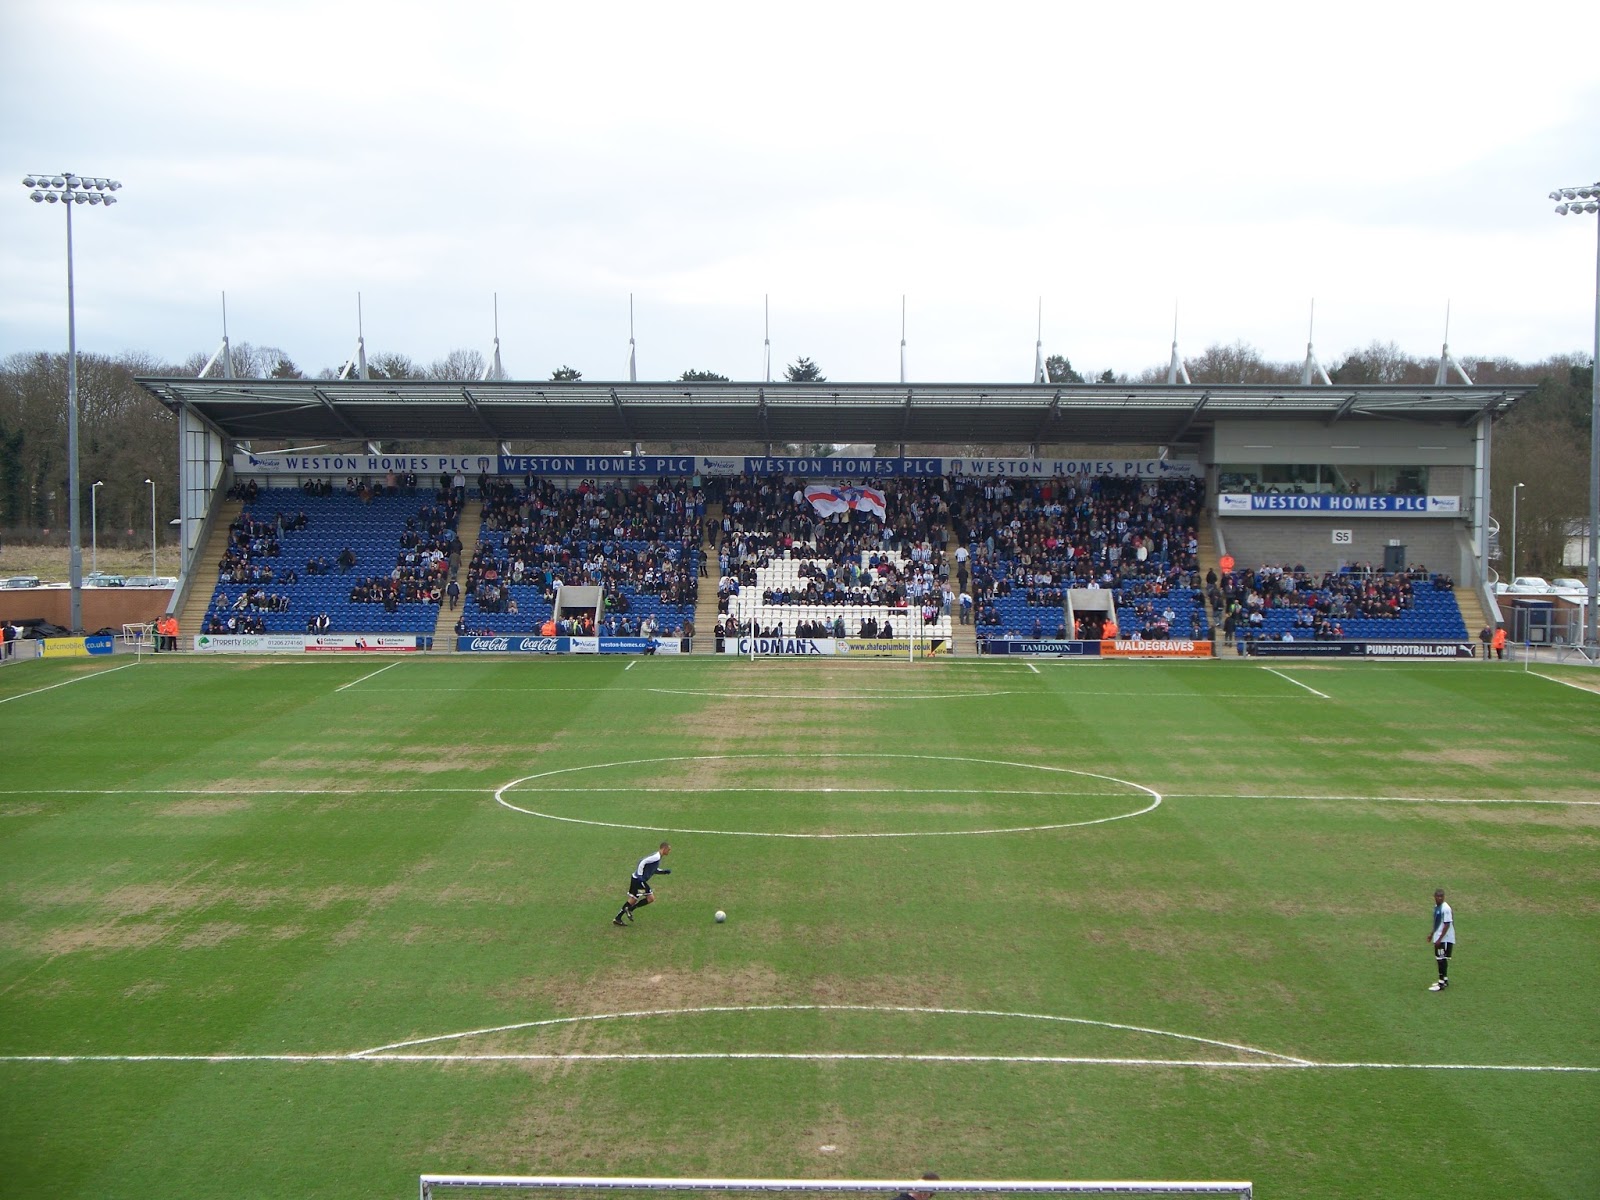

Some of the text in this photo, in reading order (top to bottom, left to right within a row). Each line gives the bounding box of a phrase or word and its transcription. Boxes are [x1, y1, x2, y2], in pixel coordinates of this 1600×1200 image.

[286, 458, 469, 470] WESTON HOMES PLC
[504, 459, 688, 471] WESTON HOMES PLC
[750, 460, 934, 473] WESTON HOMES PLC
[972, 461, 1154, 474] WESTON HOMES PLC
[1254, 496, 1425, 510] WESTON HOMES PLC
[1336, 532, 1349, 541] S5
[213, 638, 241, 646] Property
[740, 640, 806, 653] CADMAN
[850, 643, 930, 652] www.shafeplumbing.couk
[1115, 641, 1194, 651] WALDEGRAVES
[1366, 645, 1456, 655] PUMAFOOTBALL.COM
